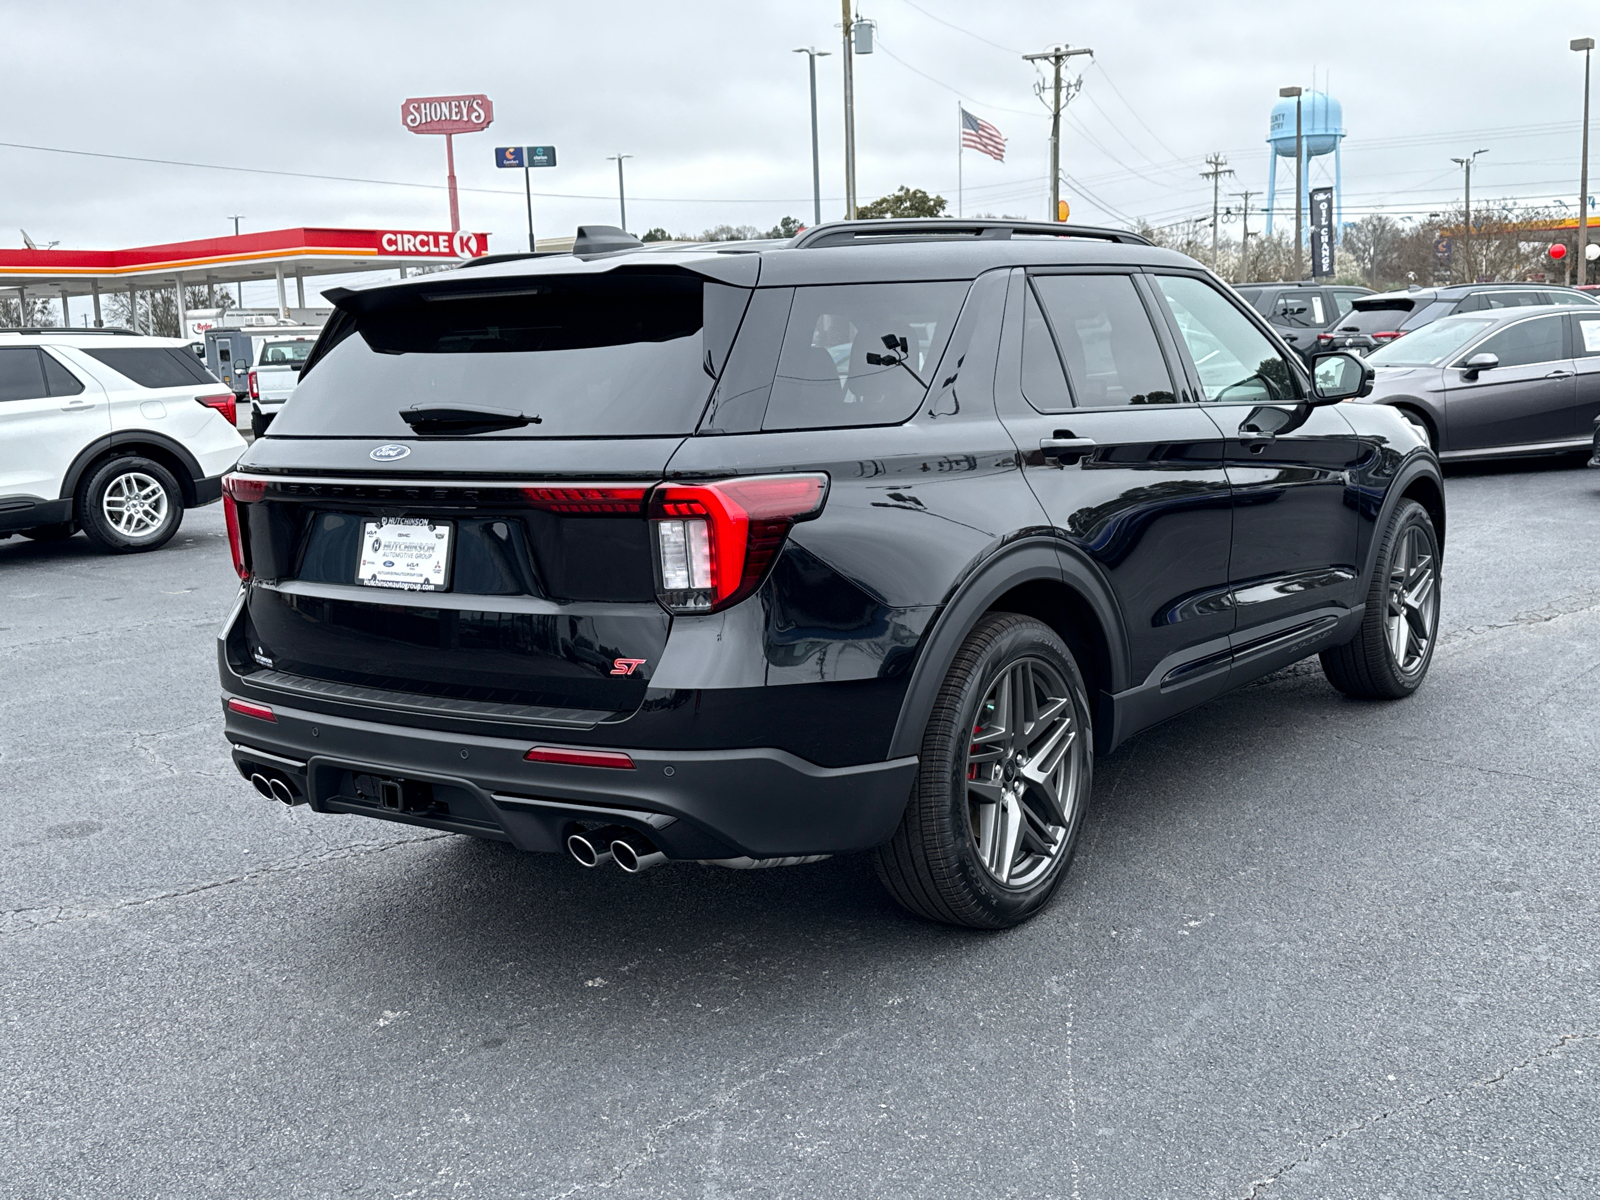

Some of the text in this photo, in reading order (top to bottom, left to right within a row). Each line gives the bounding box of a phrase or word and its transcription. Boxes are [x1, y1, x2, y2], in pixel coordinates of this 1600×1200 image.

[406, 98, 485, 127] SHONEY'S
[382, 233, 476, 257] CIRCLE K
[1319, 202, 1330, 272] OIL CHANGE
[376, 446, 401, 456] Ford
[388, 517, 429, 527] HUTCHINSON
[610, 658, 647, 675] ST
